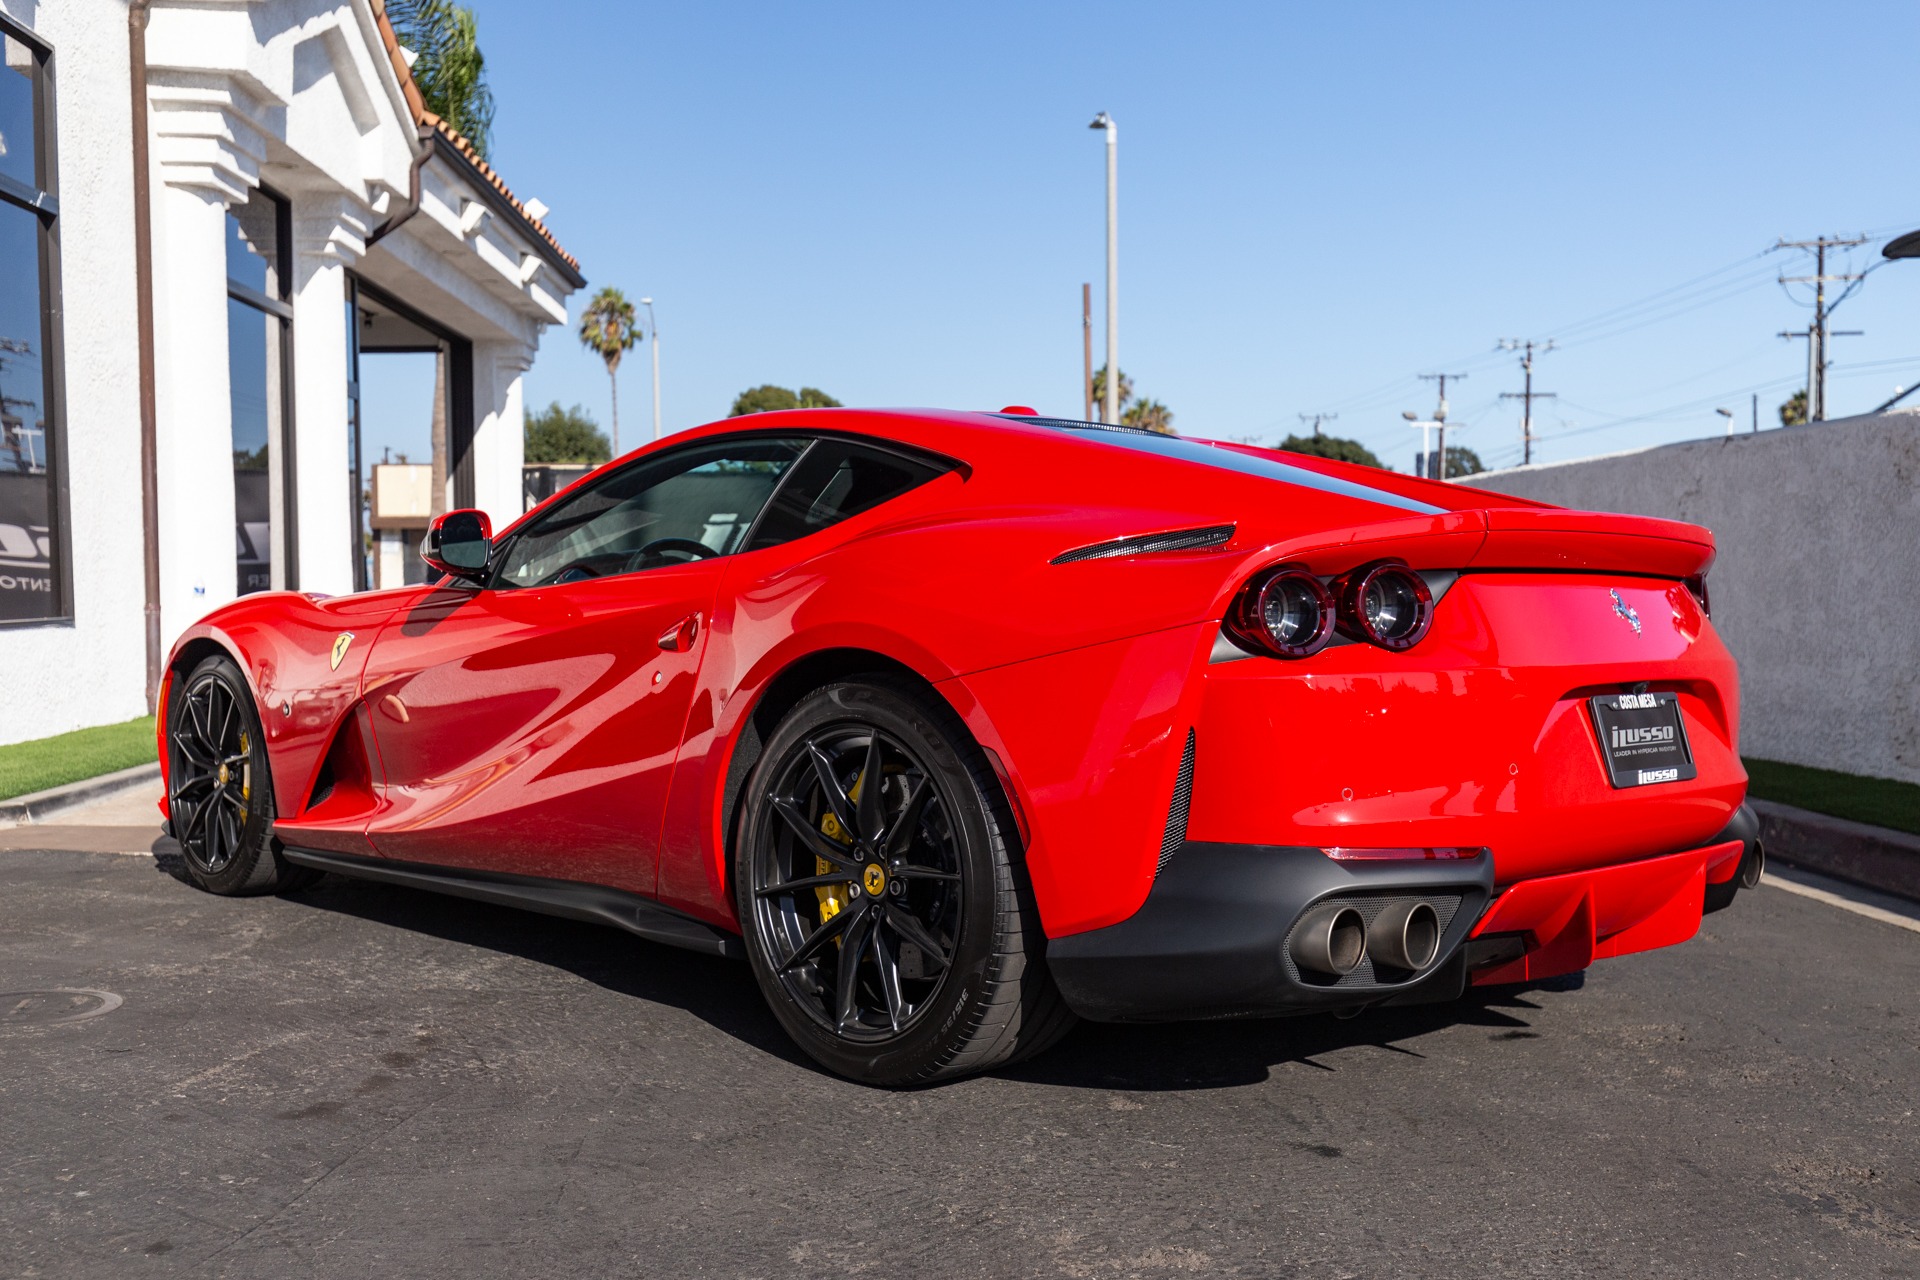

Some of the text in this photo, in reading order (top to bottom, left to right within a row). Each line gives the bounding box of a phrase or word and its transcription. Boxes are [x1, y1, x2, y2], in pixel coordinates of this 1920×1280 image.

[1619, 693, 1657, 709] COSTA MESA
[1614, 749, 1632, 757] LEADER
